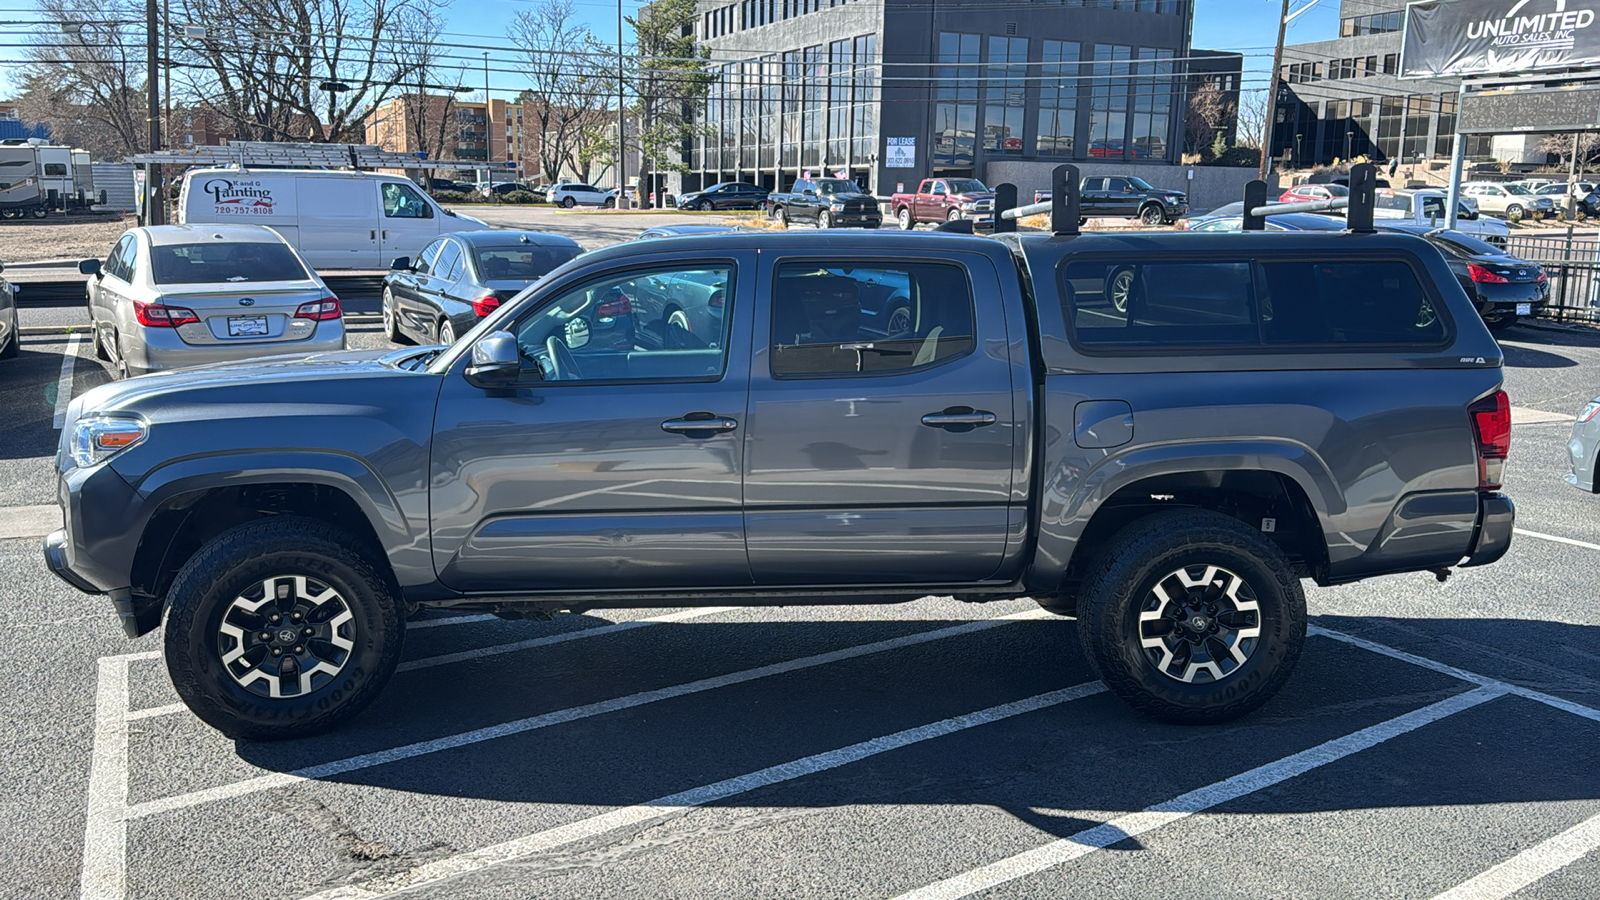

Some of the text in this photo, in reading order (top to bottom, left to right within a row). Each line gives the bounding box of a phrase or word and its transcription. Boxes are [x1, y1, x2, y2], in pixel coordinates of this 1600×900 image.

[1466, 9, 1595, 40] UNLIMITED
[1490, 34, 1520, 46] AUTO
[1554, 28, 1575, 40] INC.
[887, 136, 915, 146] FOR LEASE
[203, 178, 273, 205] Painting
[214, 206, 274, 215] 720-757-8108
